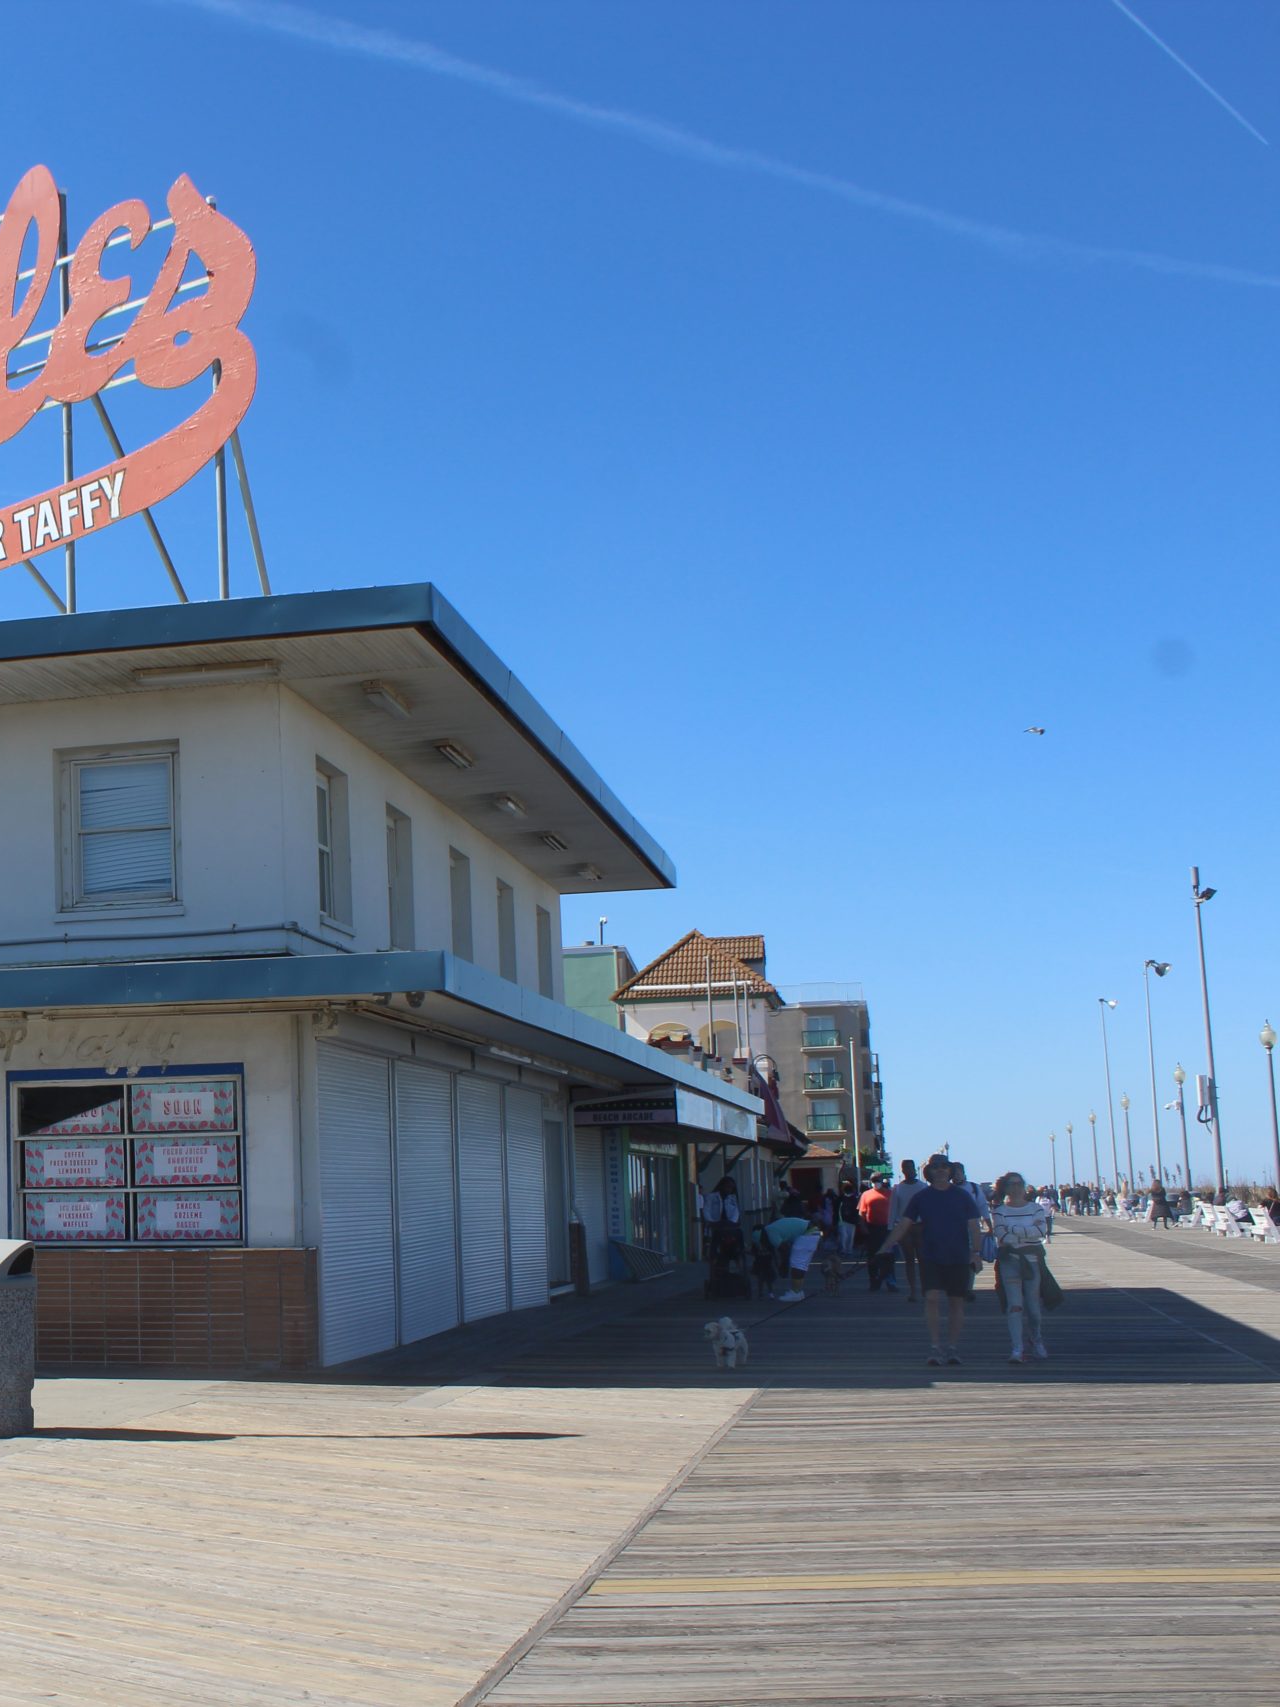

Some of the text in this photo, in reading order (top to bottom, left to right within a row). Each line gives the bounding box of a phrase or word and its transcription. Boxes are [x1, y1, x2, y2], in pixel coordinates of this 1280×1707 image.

[13, 468, 126, 554] TAFFY
[163, 1099, 202, 1116] SOON
[622, 1110, 655, 1121] ARCADE
[176, 1202, 201, 1210] SNACKS
[63, 1220, 89, 1228] WAFFLES
